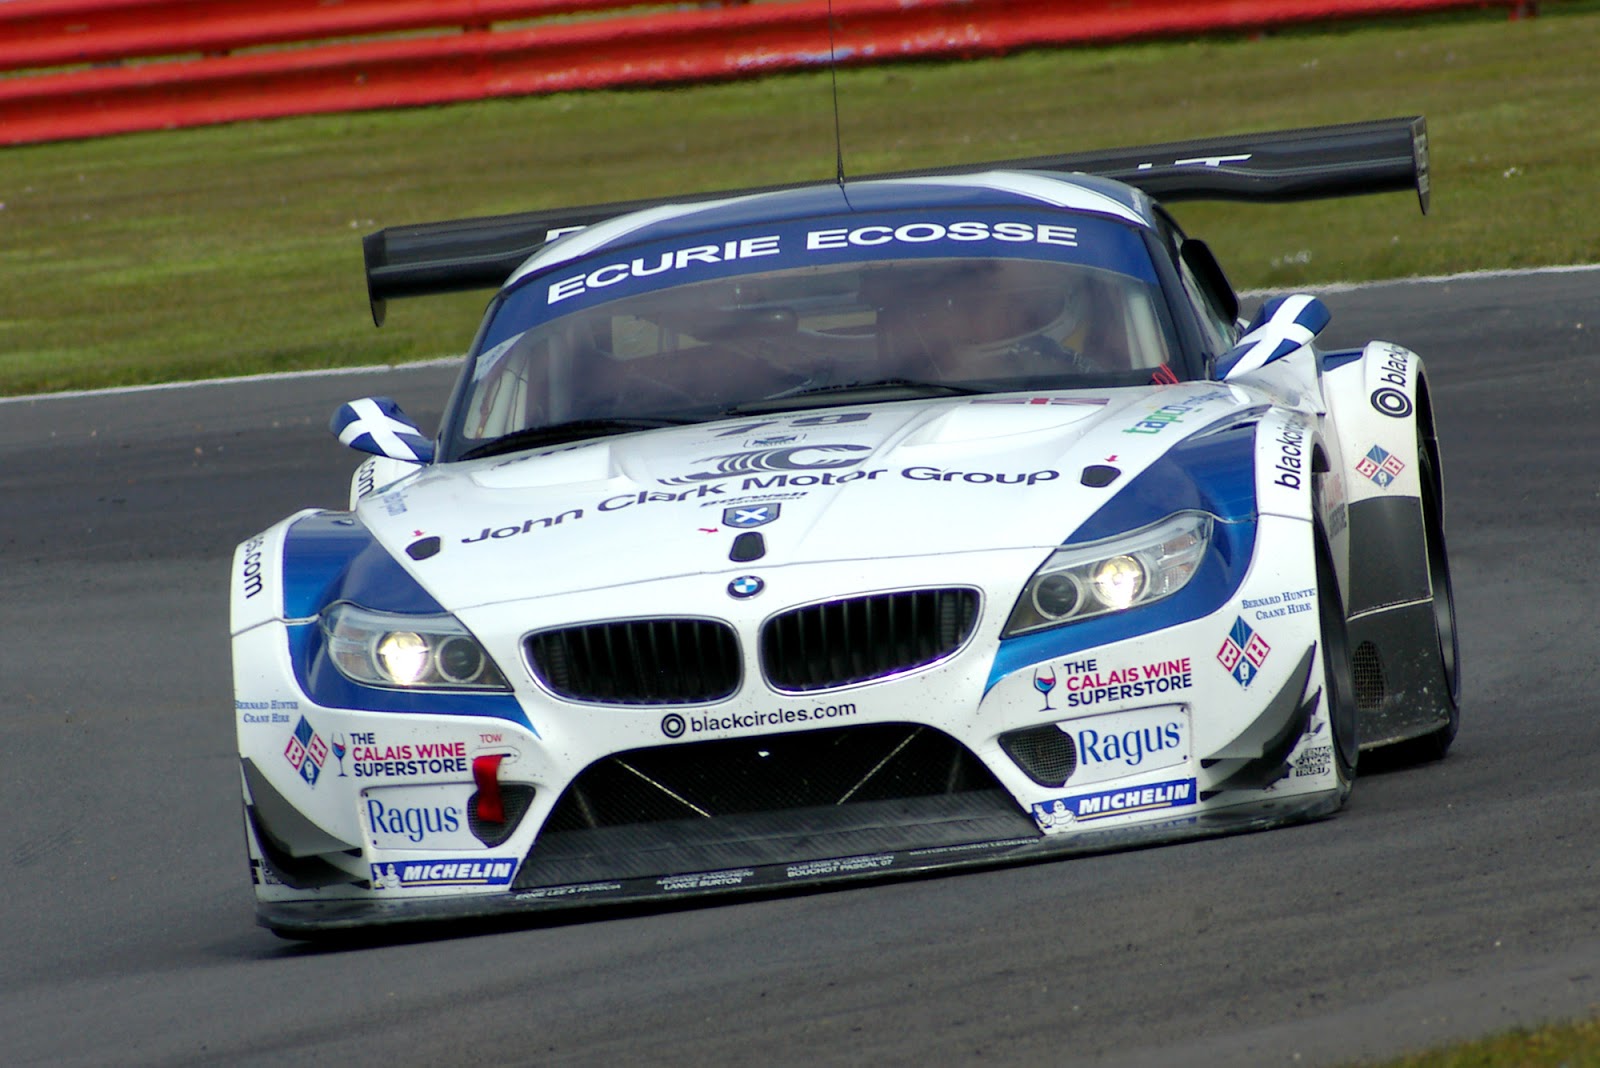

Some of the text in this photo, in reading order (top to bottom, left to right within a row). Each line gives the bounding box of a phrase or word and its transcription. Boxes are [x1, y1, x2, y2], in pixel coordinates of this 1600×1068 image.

[548, 222, 1078, 304] ECURIE ECOSSE
[461, 466, 1060, 544] John Clark Motor Group
[1281, 588, 1316, 602] HUNTE
[1255, 603, 1312, 621] CRANE HIRE
[1063, 659, 1097, 675] THE
[1067, 657, 1192, 692] CALAIS WINE
[1067, 673, 1193, 707] SUPERSTORE
[691, 703, 857, 733] blackcircles.com
[350, 733, 376, 745] THE
[479, 733, 502, 743] TOW
[1078, 722, 1180, 765] Ragus
[353, 742, 467, 761] CALAIS WINE
[354, 757, 468, 777] SUPERSTORE
[1079, 783, 1190, 815] MICHELIN
[367, 799, 459, 842] Ragus
[401, 862, 511, 881] MICHELIN
[841, 862, 879, 874] PASCAL
[699, 877, 742, 887] BURTON
